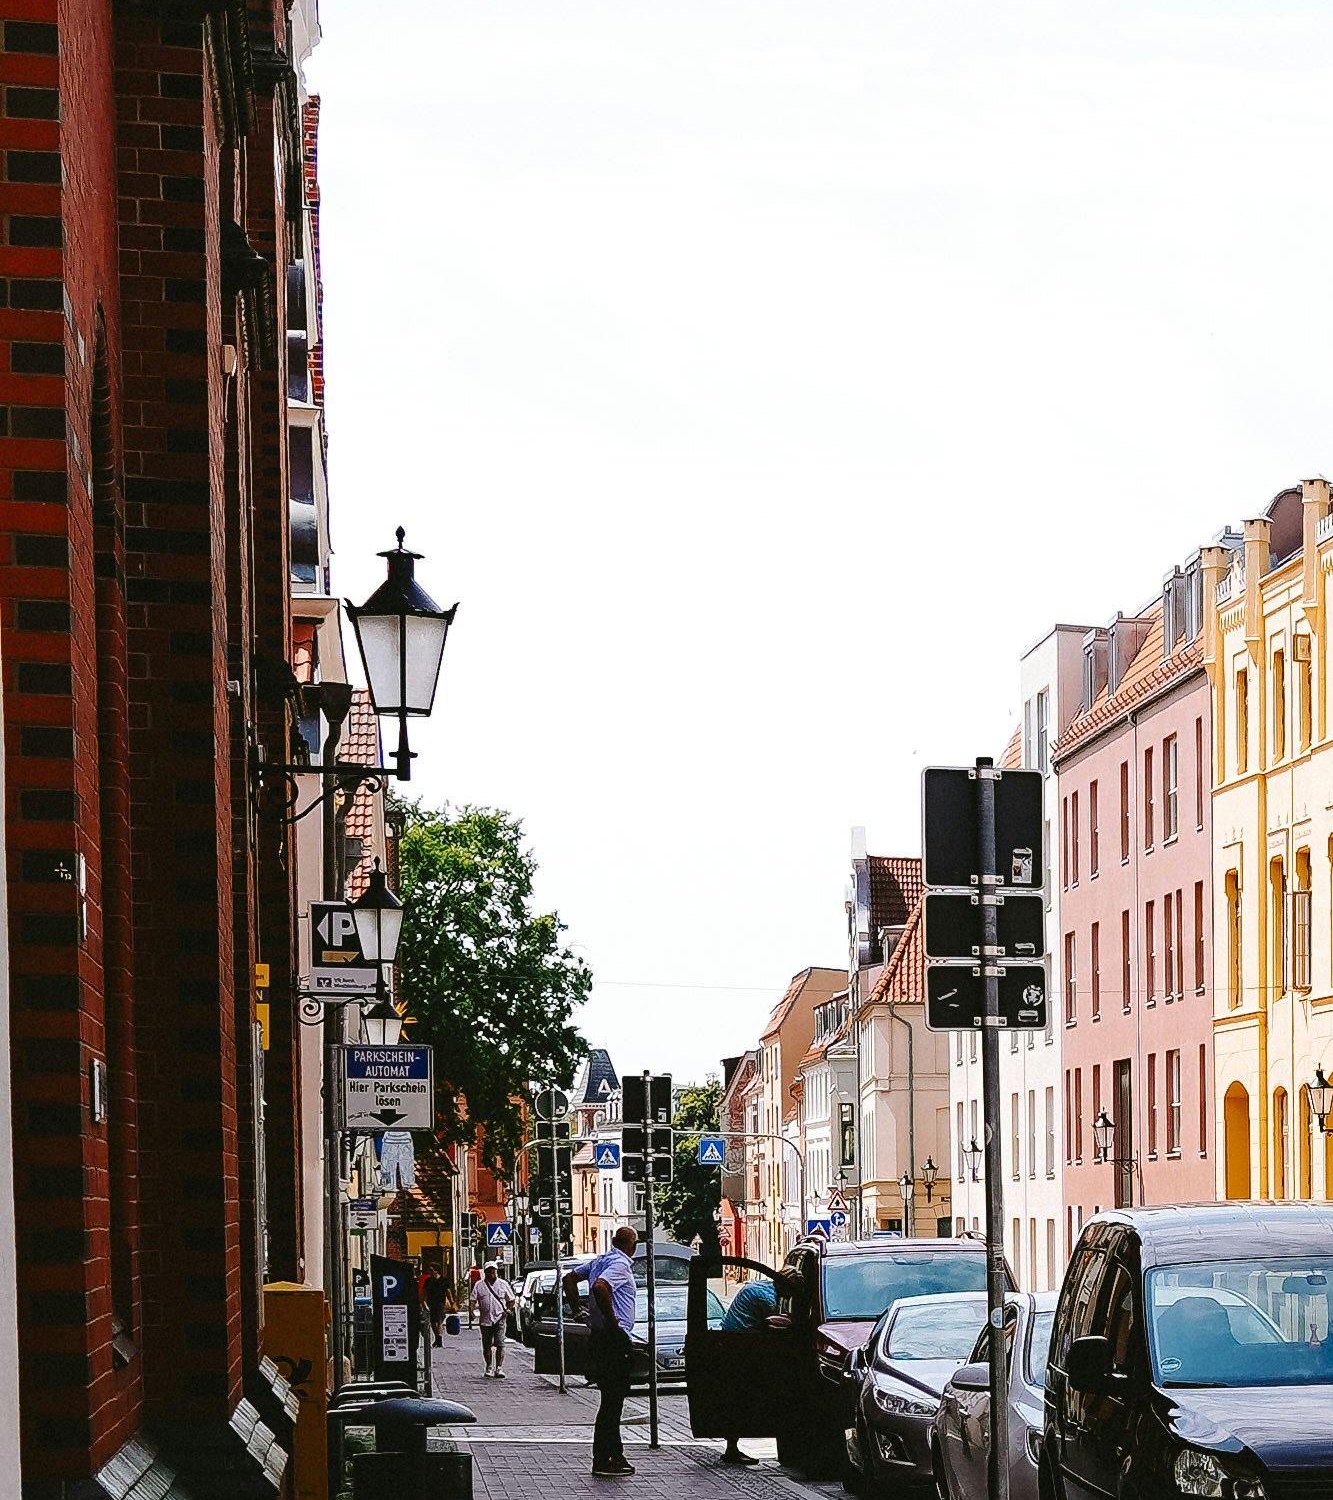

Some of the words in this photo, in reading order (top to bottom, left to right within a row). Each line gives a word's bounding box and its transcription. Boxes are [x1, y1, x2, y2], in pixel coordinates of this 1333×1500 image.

[332, 911, 356, 947] P
[354, 1050, 421, 1063] PARKSCHEIN-
[365, 1065, 410, 1077] AUTOMAT
[349, 1081, 370, 1093] Hier
[373, 1081, 427, 1094] Parkschein
[375, 1095, 401, 1107] lösen
[382, 1275, 398, 1298] P
